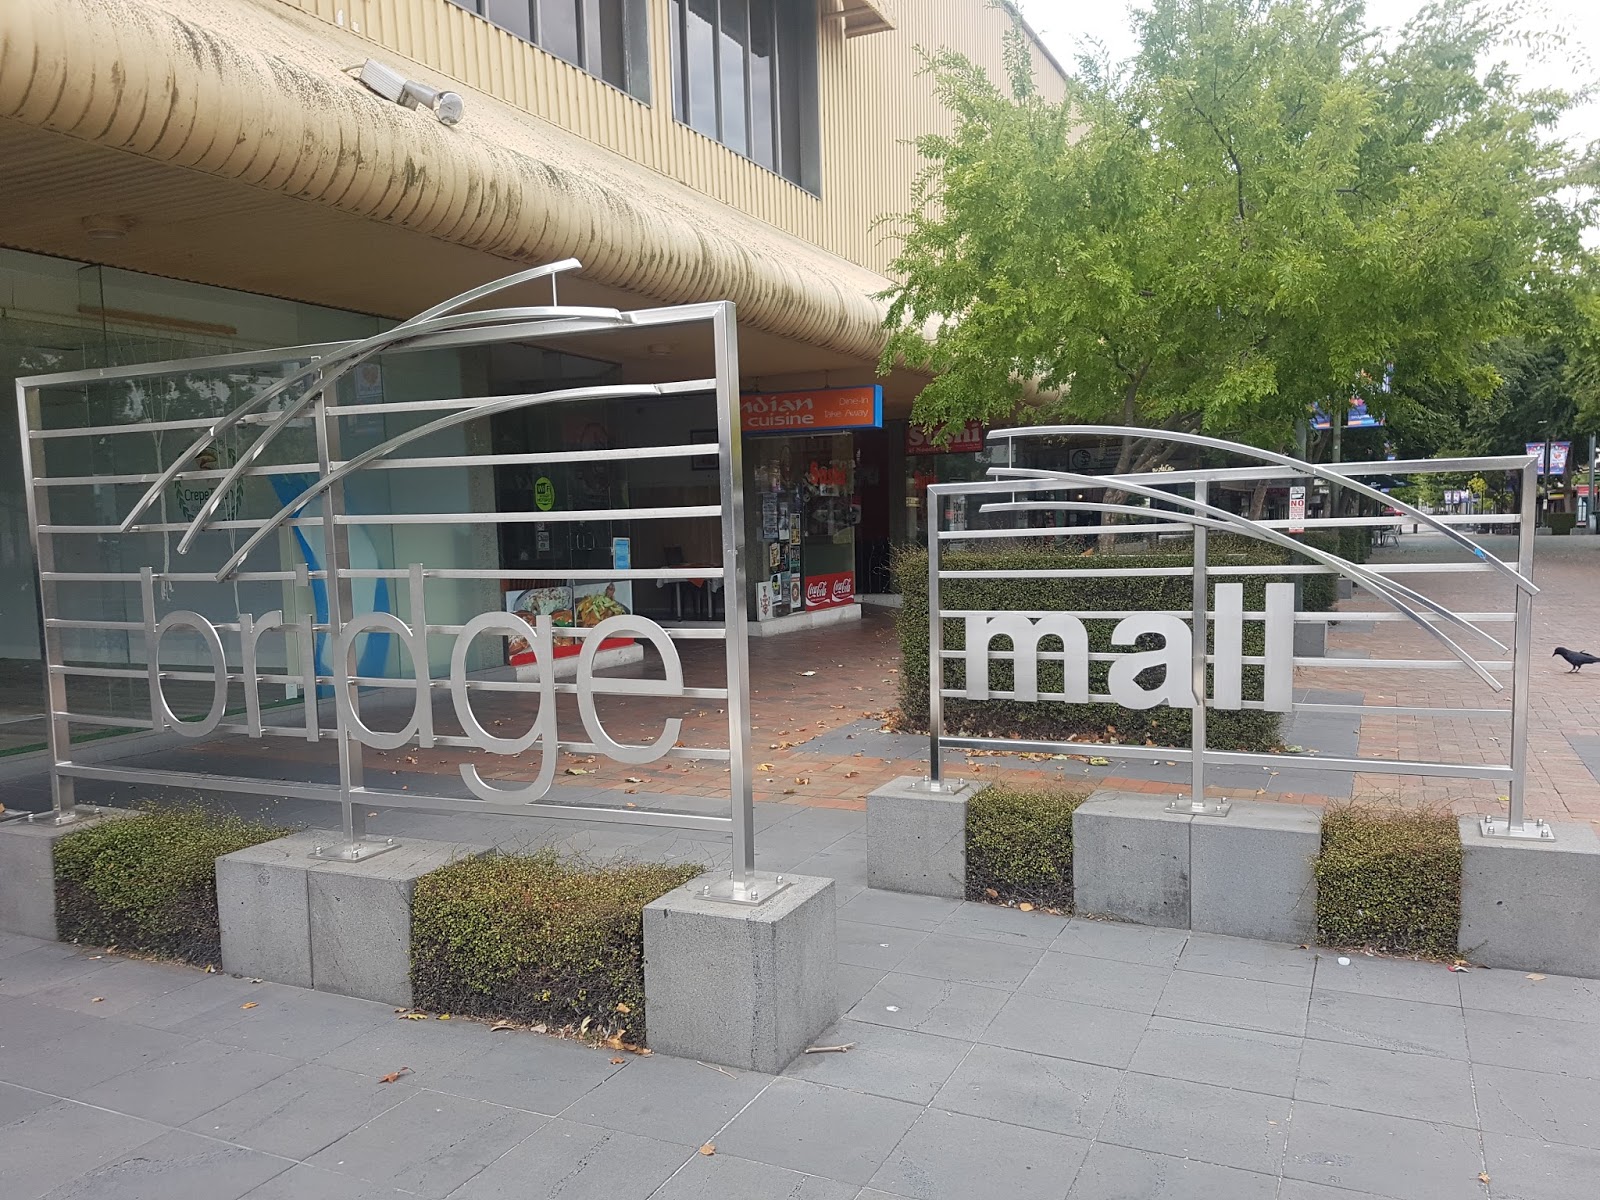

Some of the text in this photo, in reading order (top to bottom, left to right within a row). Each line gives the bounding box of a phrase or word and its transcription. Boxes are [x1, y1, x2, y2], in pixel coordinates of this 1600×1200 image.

[740, 396, 814, 414] ndian
[844, 408, 868, 418] Away
[747, 412, 814, 427] cuisine
[965, 582, 1295, 712] mall
[140, 563, 683, 805] bridge
